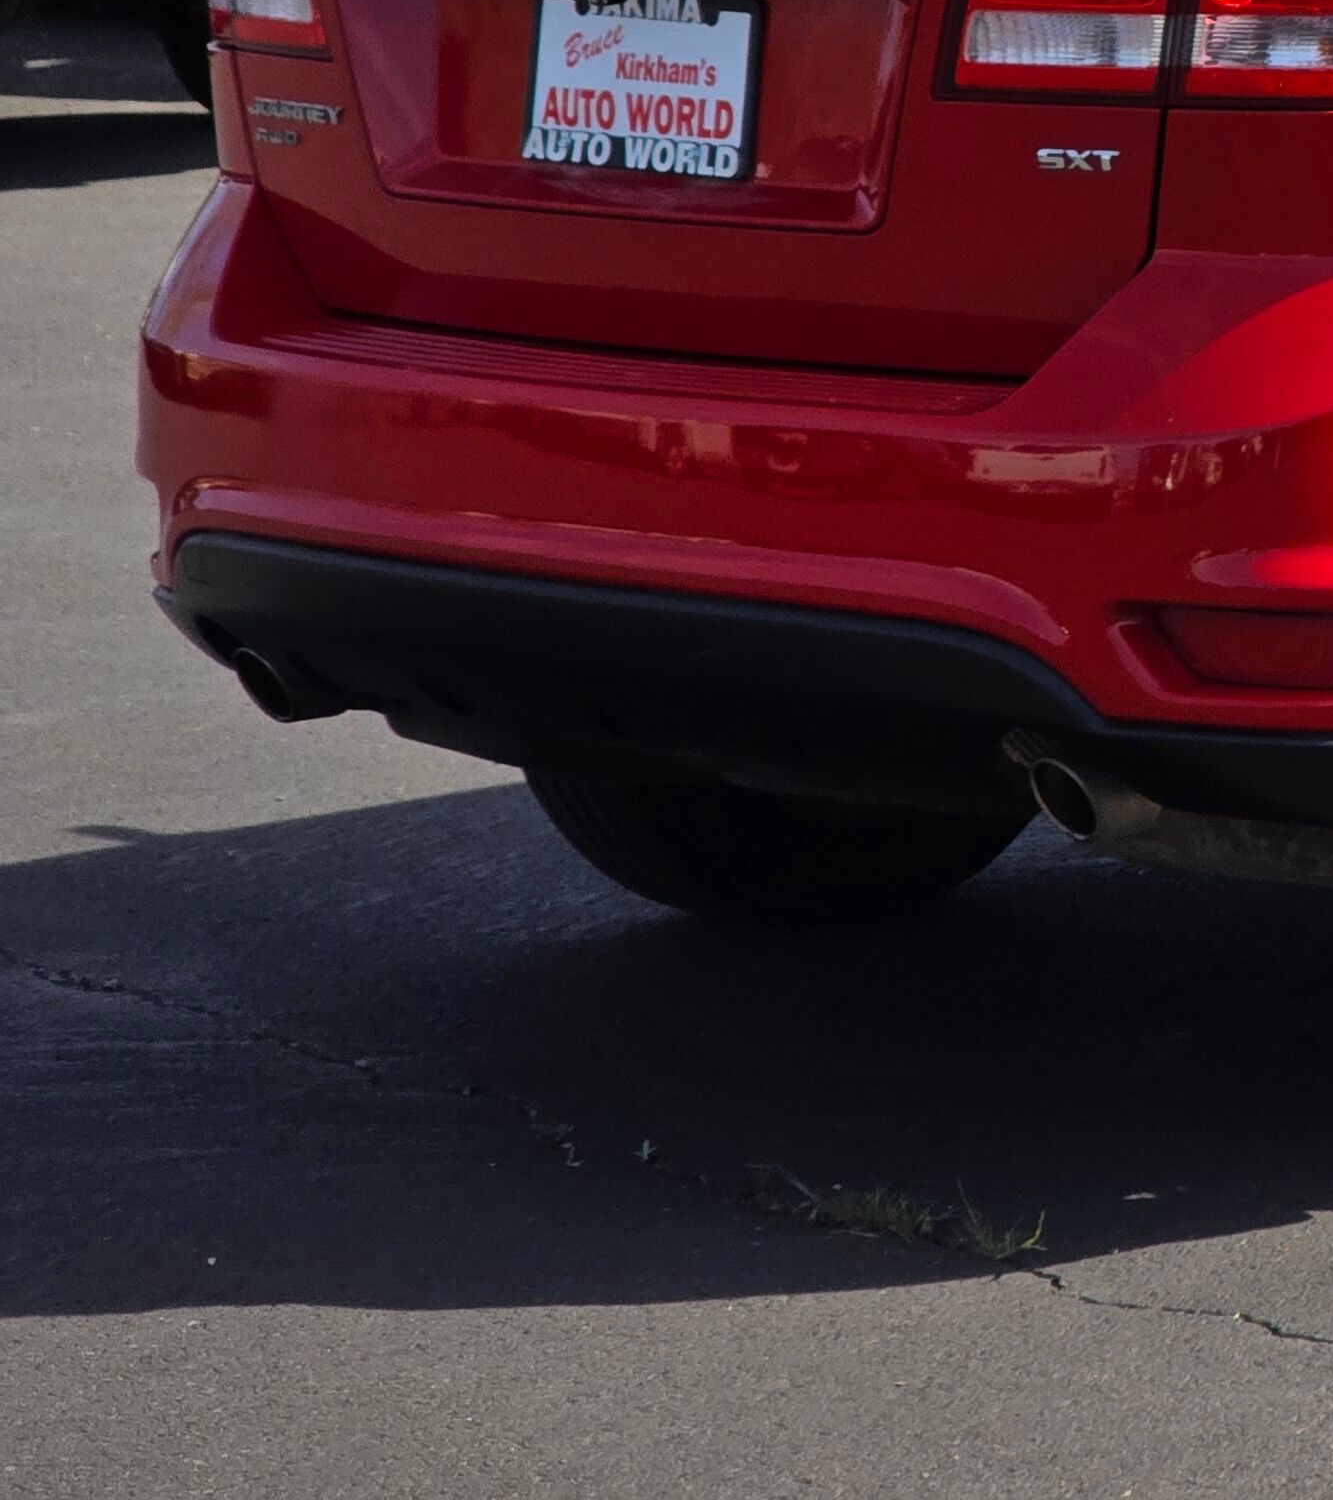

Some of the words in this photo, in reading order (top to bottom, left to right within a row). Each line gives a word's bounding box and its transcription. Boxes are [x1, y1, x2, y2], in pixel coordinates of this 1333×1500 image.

[615, 51, 717, 88] Kirkham's
[541, 86, 616, 131] AUTO
[625, 92, 735, 141] WORLD
[521, 126, 613, 168] AUTO
[623, 134, 739, 180] WORLD
[1036, 148, 1121, 172] SXT
